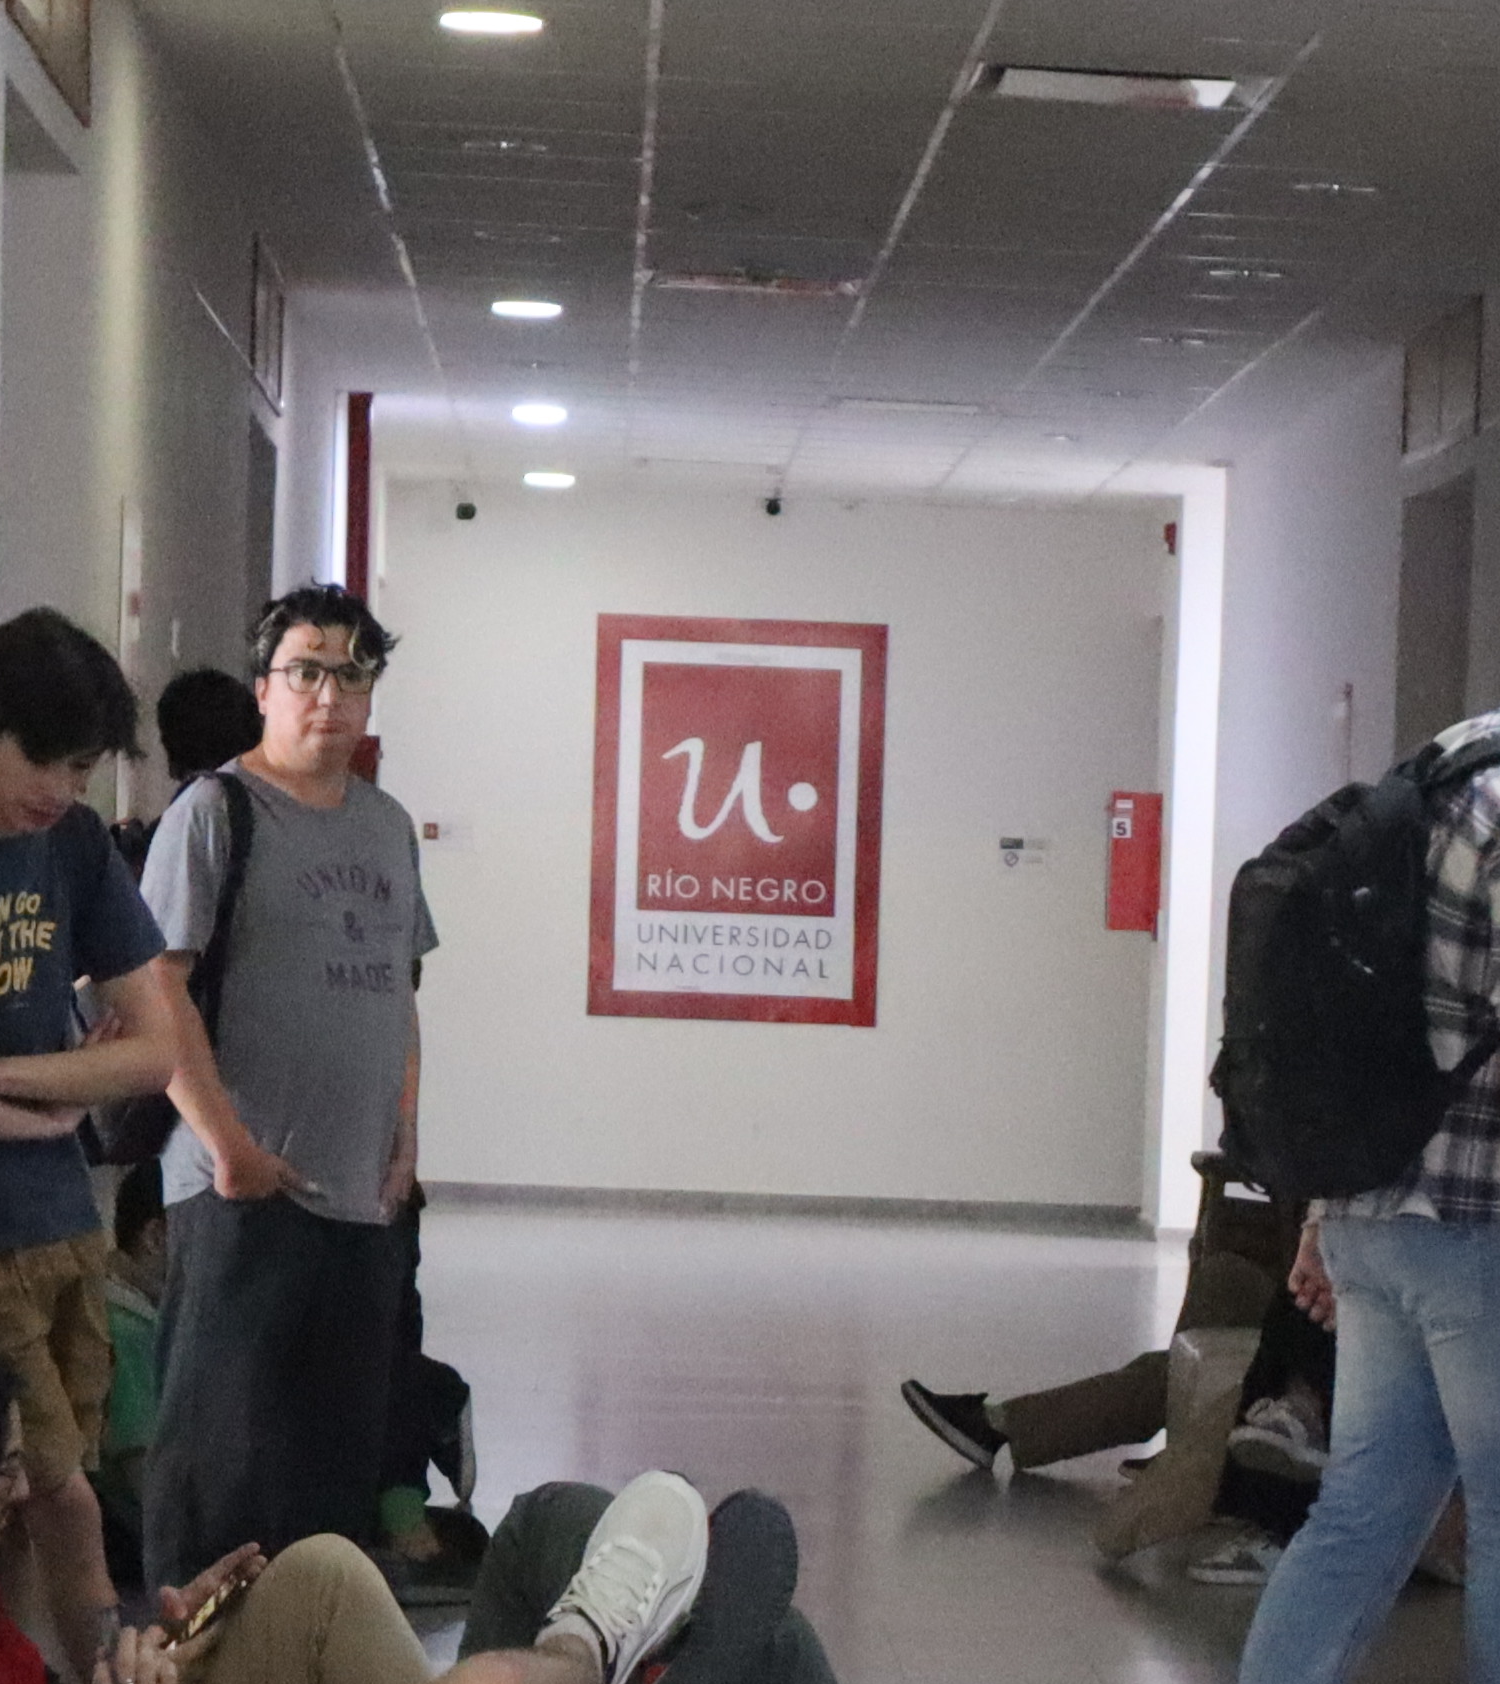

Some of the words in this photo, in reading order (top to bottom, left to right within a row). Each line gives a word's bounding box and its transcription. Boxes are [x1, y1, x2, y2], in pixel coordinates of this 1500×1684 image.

[1116, 821, 1128, 836] 5
[296, 864, 393, 902] UNION
[647, 868, 700, 898] RÍO
[711, 876, 827, 904] NEGRO
[15, 891, 41, 914] GO
[8, 920, 57, 950] THE
[636, 923, 833, 950] UNIVERSIDAD
[325, 961, 396, 993] MADE
[636, 952, 830, 979] NACIONAL
